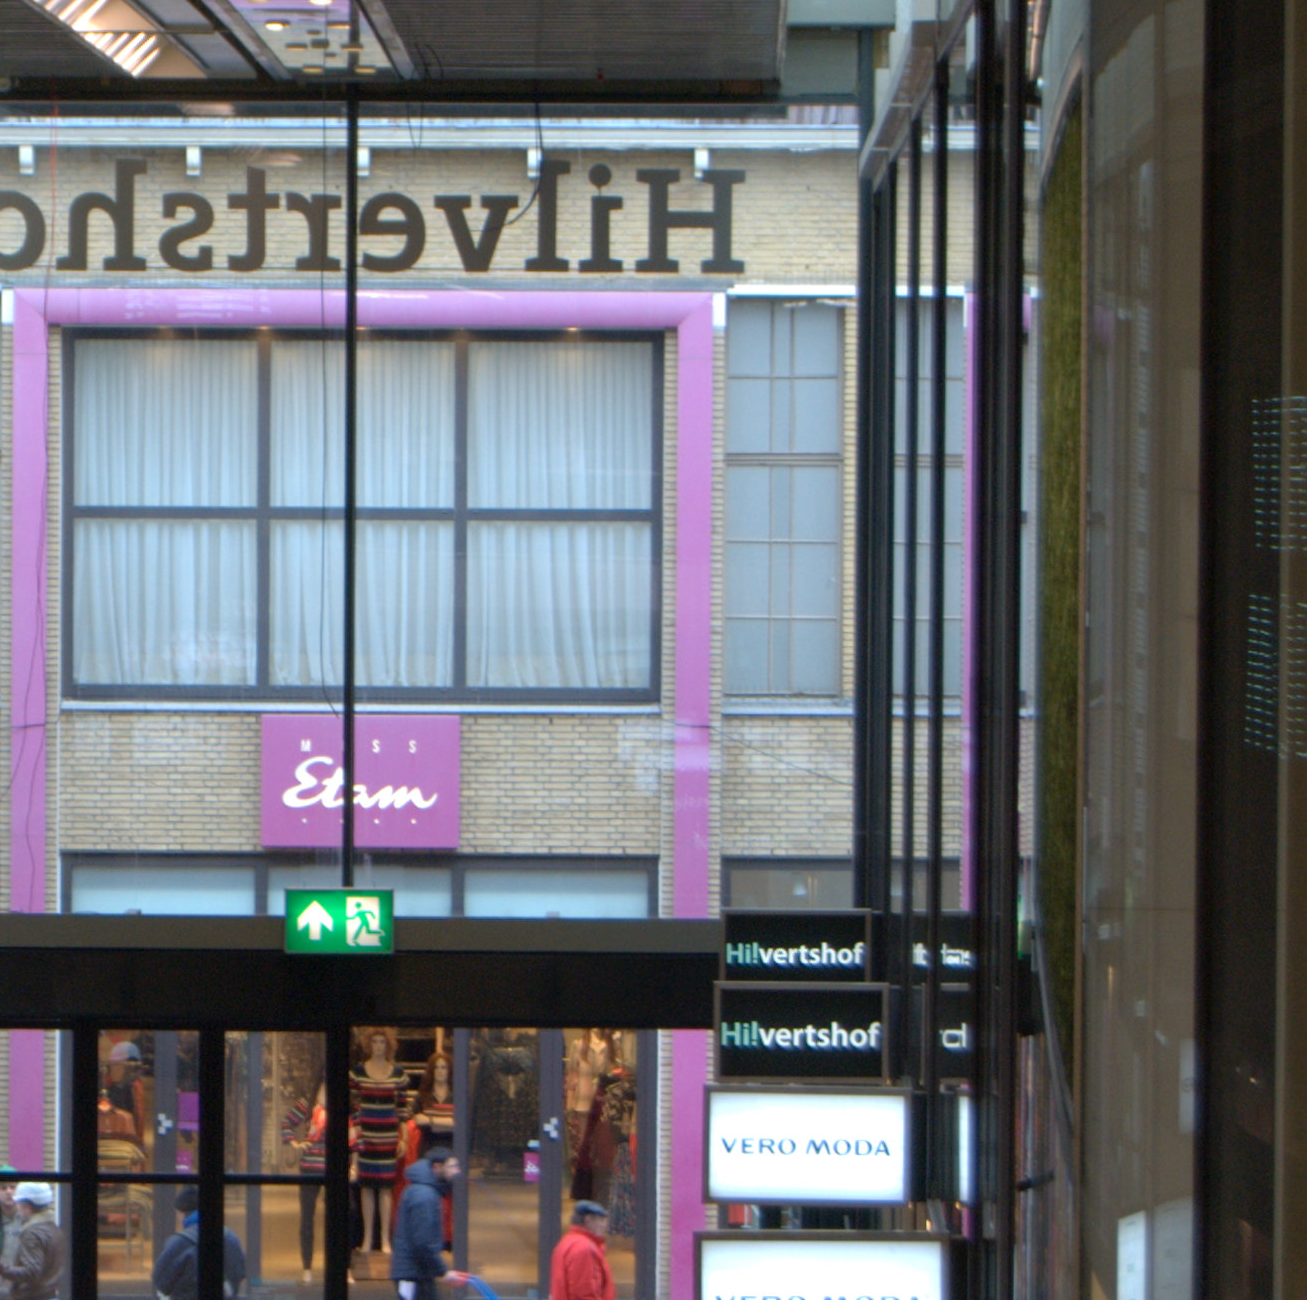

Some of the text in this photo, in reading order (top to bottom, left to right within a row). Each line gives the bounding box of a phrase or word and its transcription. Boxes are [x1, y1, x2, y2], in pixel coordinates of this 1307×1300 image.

[300, 739, 418, 753] MSS
[282, 756, 438, 809] Etam
[726, 941, 867, 966] Hi!vertshof
[720, 1020, 882, 1048] Hi!vertshof
[721, 1137, 891, 1157] VERO MODA
